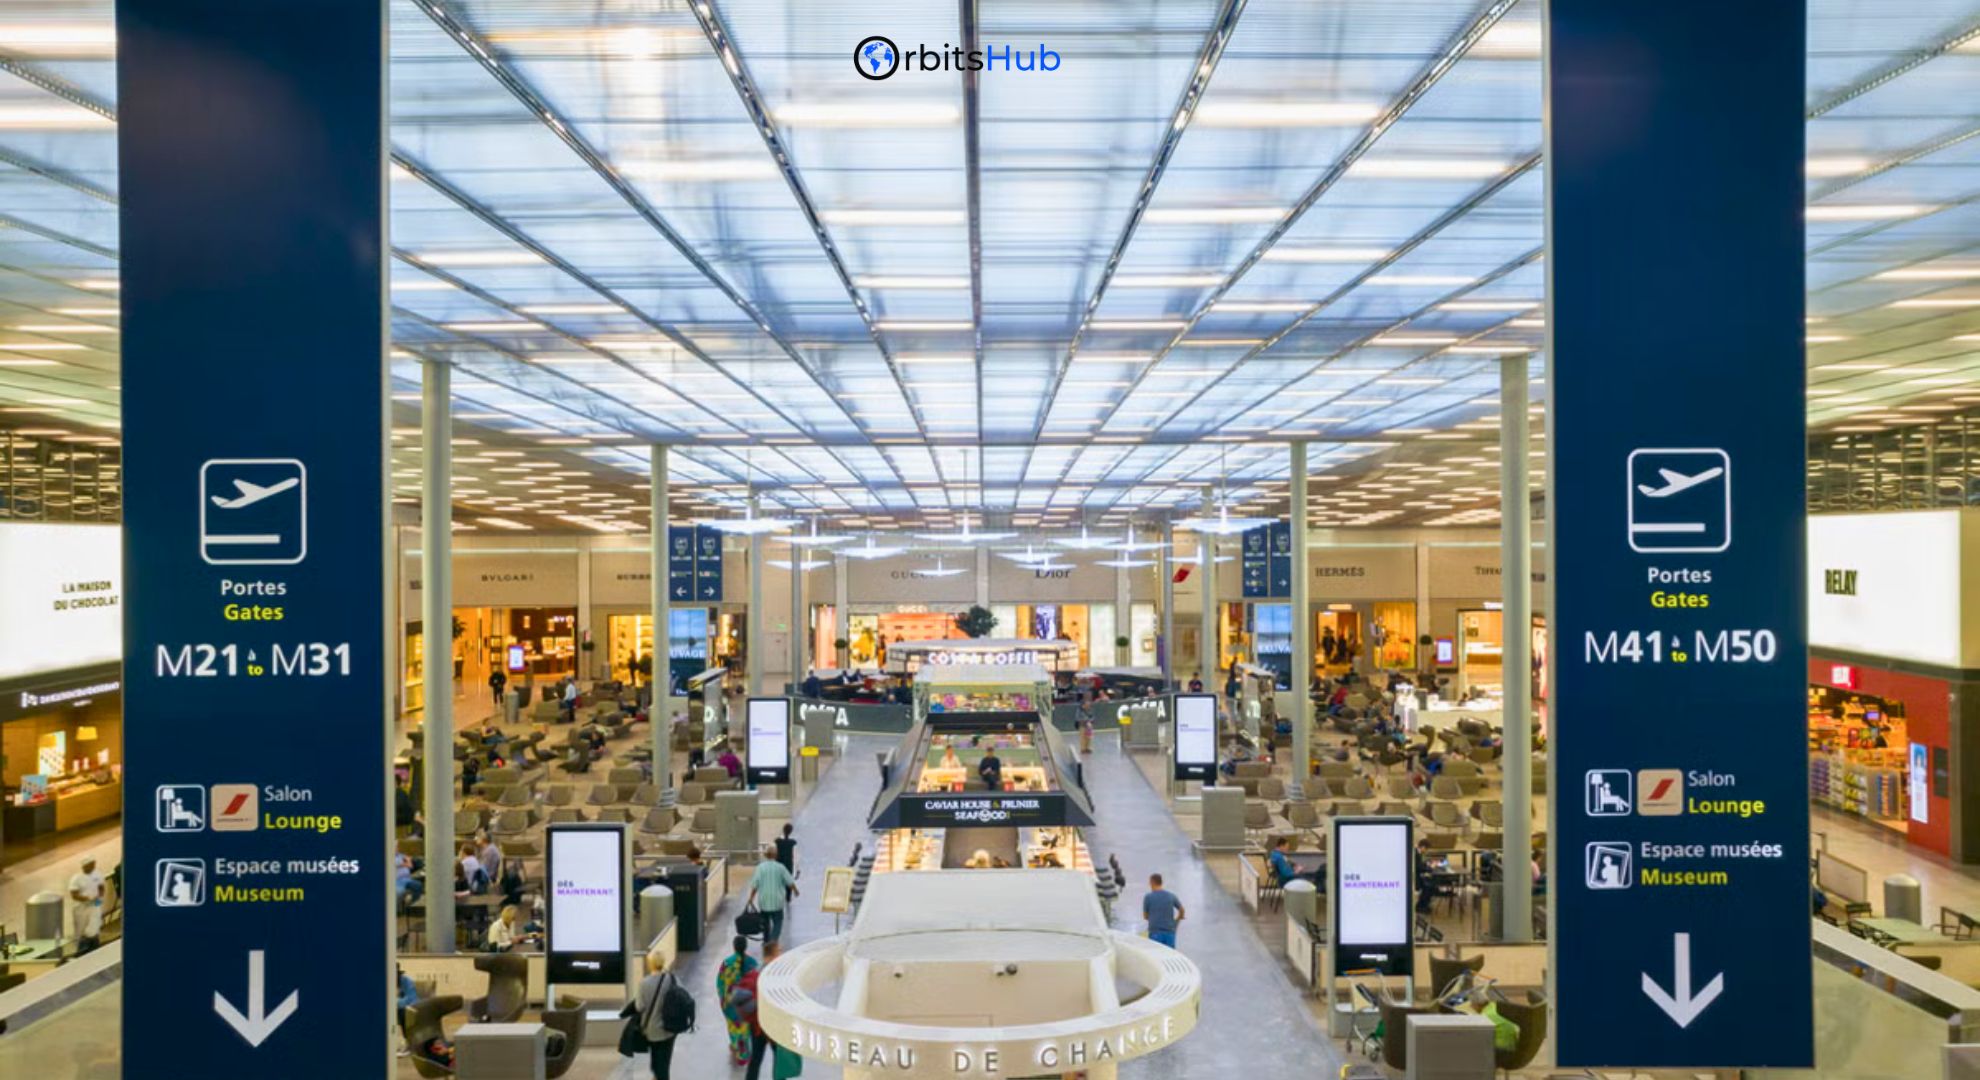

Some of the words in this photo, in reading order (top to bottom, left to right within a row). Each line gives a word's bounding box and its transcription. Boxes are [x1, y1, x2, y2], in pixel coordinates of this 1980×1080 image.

[1648, 566, 1712, 584] Portes
[1825, 568, 1858, 597] RELAY
[62, 583, 75, 593] LA
[78, 580, 112, 592] MAISON
[220, 579, 287, 596] Portes
[53, 599, 68, 611] DU
[70, 595, 119, 610] CHOCOLAT
[1650, 591, 1711, 609] Gates
[224, 604, 285, 621] Gates
[1585, 630, 1663, 663] M41
[1670, 651, 1688, 663] to
[1695, 629, 1777, 663] M50
[156, 644, 238, 677] M21
[247, 664, 264, 676] to
[271, 643, 351, 676] M31
[1688, 769, 1736, 787] Salon
[264, 784, 313, 802] Salon
[925, 801, 959, 809] CAVIAR
[960, 800, 991, 809] HOUSE
[1001, 800, 1040, 809] PRUNIER
[1688, 797, 1766, 818] Lounge
[264, 813, 342, 834] Lounge
[1641, 841, 1706, 862] Espace
[1711, 839, 1783, 858] musées
[215, 857, 282, 879] Espace
[287, 855, 360, 874] musées
[1640, 867, 1729, 886] Museum
[215, 884, 305, 903] Museum
[791, 1023, 914, 1070] BUREAU
[954, 1050, 999, 1073] DE
[1040, 1015, 1175, 1067] CHANGE
